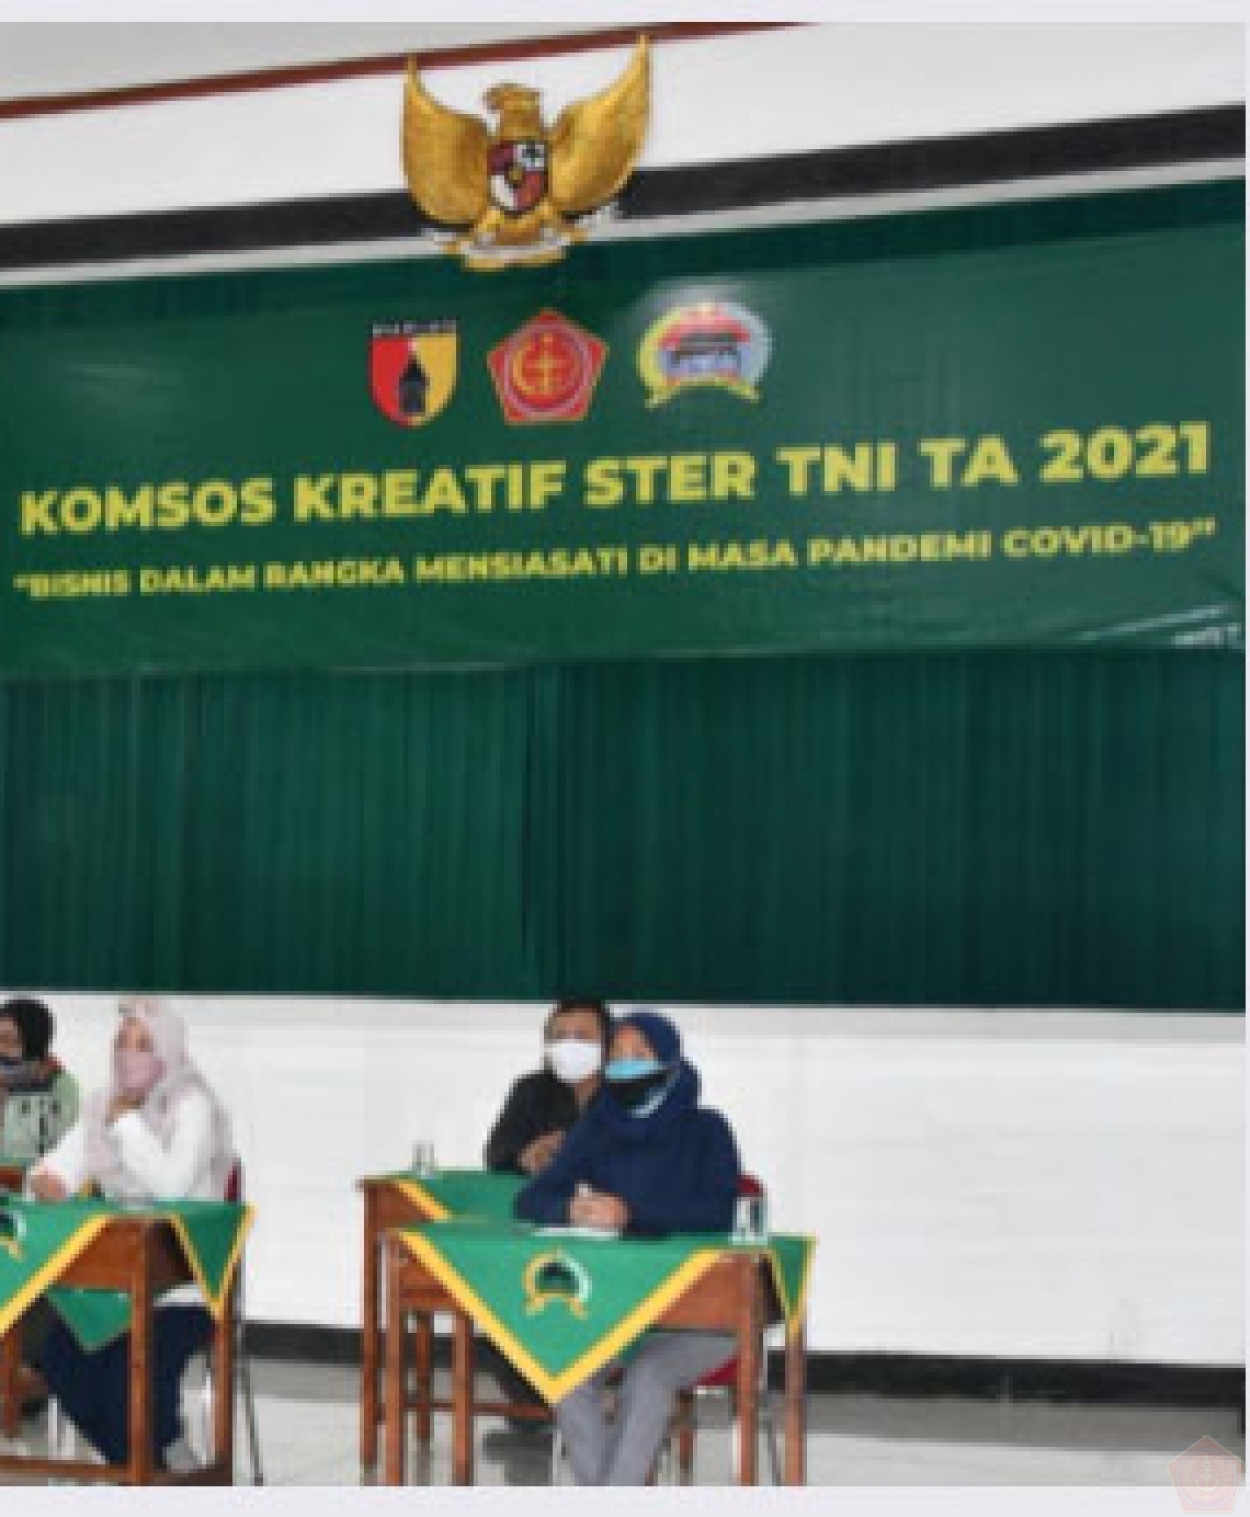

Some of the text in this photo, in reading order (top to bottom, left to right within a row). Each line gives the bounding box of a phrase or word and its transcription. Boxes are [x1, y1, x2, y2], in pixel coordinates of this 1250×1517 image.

[20, 420, 1210, 536] KOMSOS KREATIF STER TNI TA 2021
[139, 562, 256, 596] DALAM
[264, 555, 406, 591] RANGKA
[415, 544, 628, 583] MENSIASATI
[638, 543, 678, 575] DI
[688, 537, 798, 573] MASA
[807, 530, 993, 567] PANDEMI
